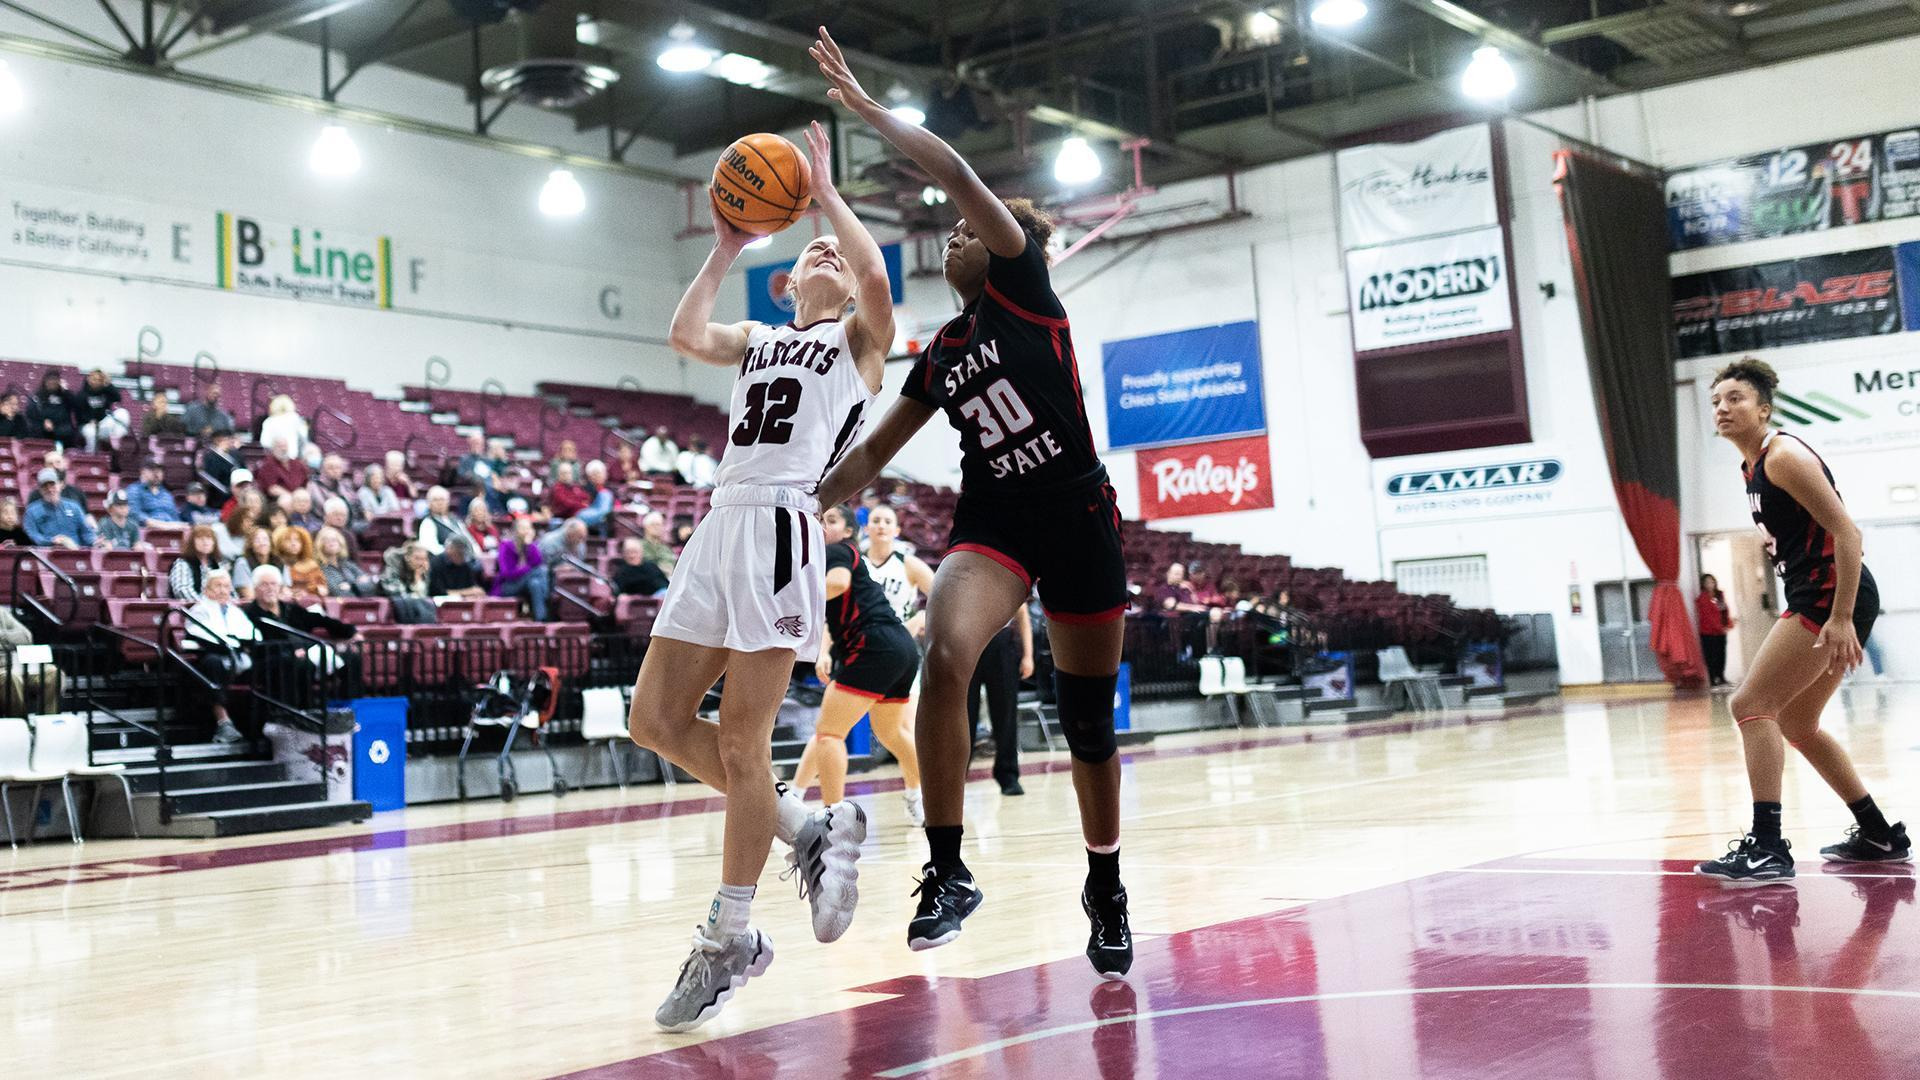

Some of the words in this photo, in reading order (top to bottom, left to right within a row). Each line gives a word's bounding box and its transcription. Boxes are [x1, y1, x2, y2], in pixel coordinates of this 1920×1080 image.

[721, 147, 766, 192] Wilson
[1768, 150, 1809, 188] 12
[1829, 140, 1872, 175] 24
[713, 178, 746, 213] NCAA
[25, 228, 74, 250] Better
[86, 213, 146, 239] Building
[172, 222, 192, 263] E
[236, 219, 266, 266] B
[292, 227, 376, 283] Line
[408, 257, 426, 294] F
[1360, 255, 1500, 311] MODERN
[1720, 270, 1894, 317] BLAZE
[600, 284, 622, 320] G
[944, 338, 1001, 397] STAN
[1121, 371, 1168, 390] Proudly
[1171, 361, 1243, 381] supporting
[731, 376, 803, 447] 32
[958, 377, 1034, 449] 30
[1119, 393, 1155, 410] Chico
[1156, 389, 1190, 405] State
[1190, 380, 1248, 398] Athletics
[988, 429, 1063, 479] STATE
[1152, 453, 1259, 506] Raley's
[1397, 463, 1546, 494] LAMAR
